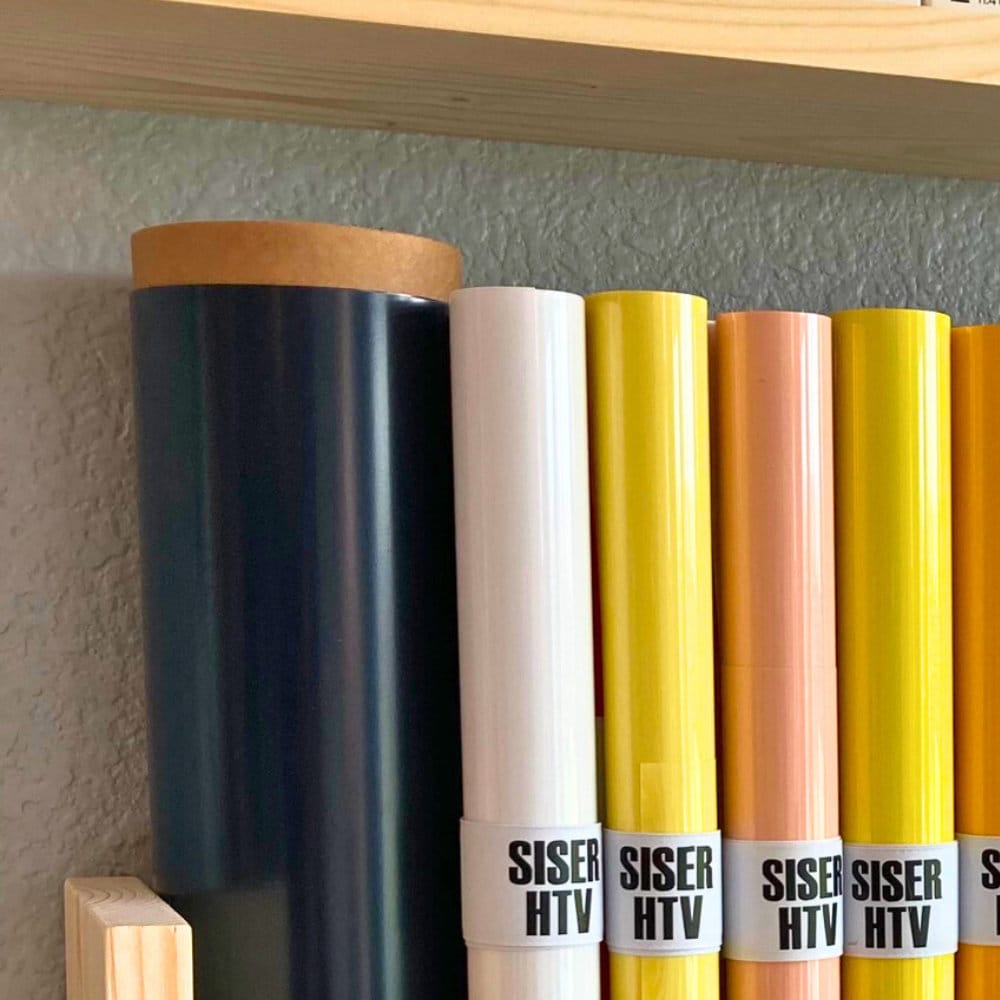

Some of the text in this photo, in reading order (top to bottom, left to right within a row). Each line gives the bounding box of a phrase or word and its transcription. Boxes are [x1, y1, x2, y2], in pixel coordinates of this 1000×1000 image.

[509, 838, 600, 884] SISER
[620, 845, 712, 890] SISER
[763, 855, 842, 901] SISER
[851, 859, 942, 901] SISER
[526, 889, 592, 935] HTV
[634, 895, 704, 940] HTV
[779, 904, 837, 950] HTV
[865, 906, 929, 948] HTV
